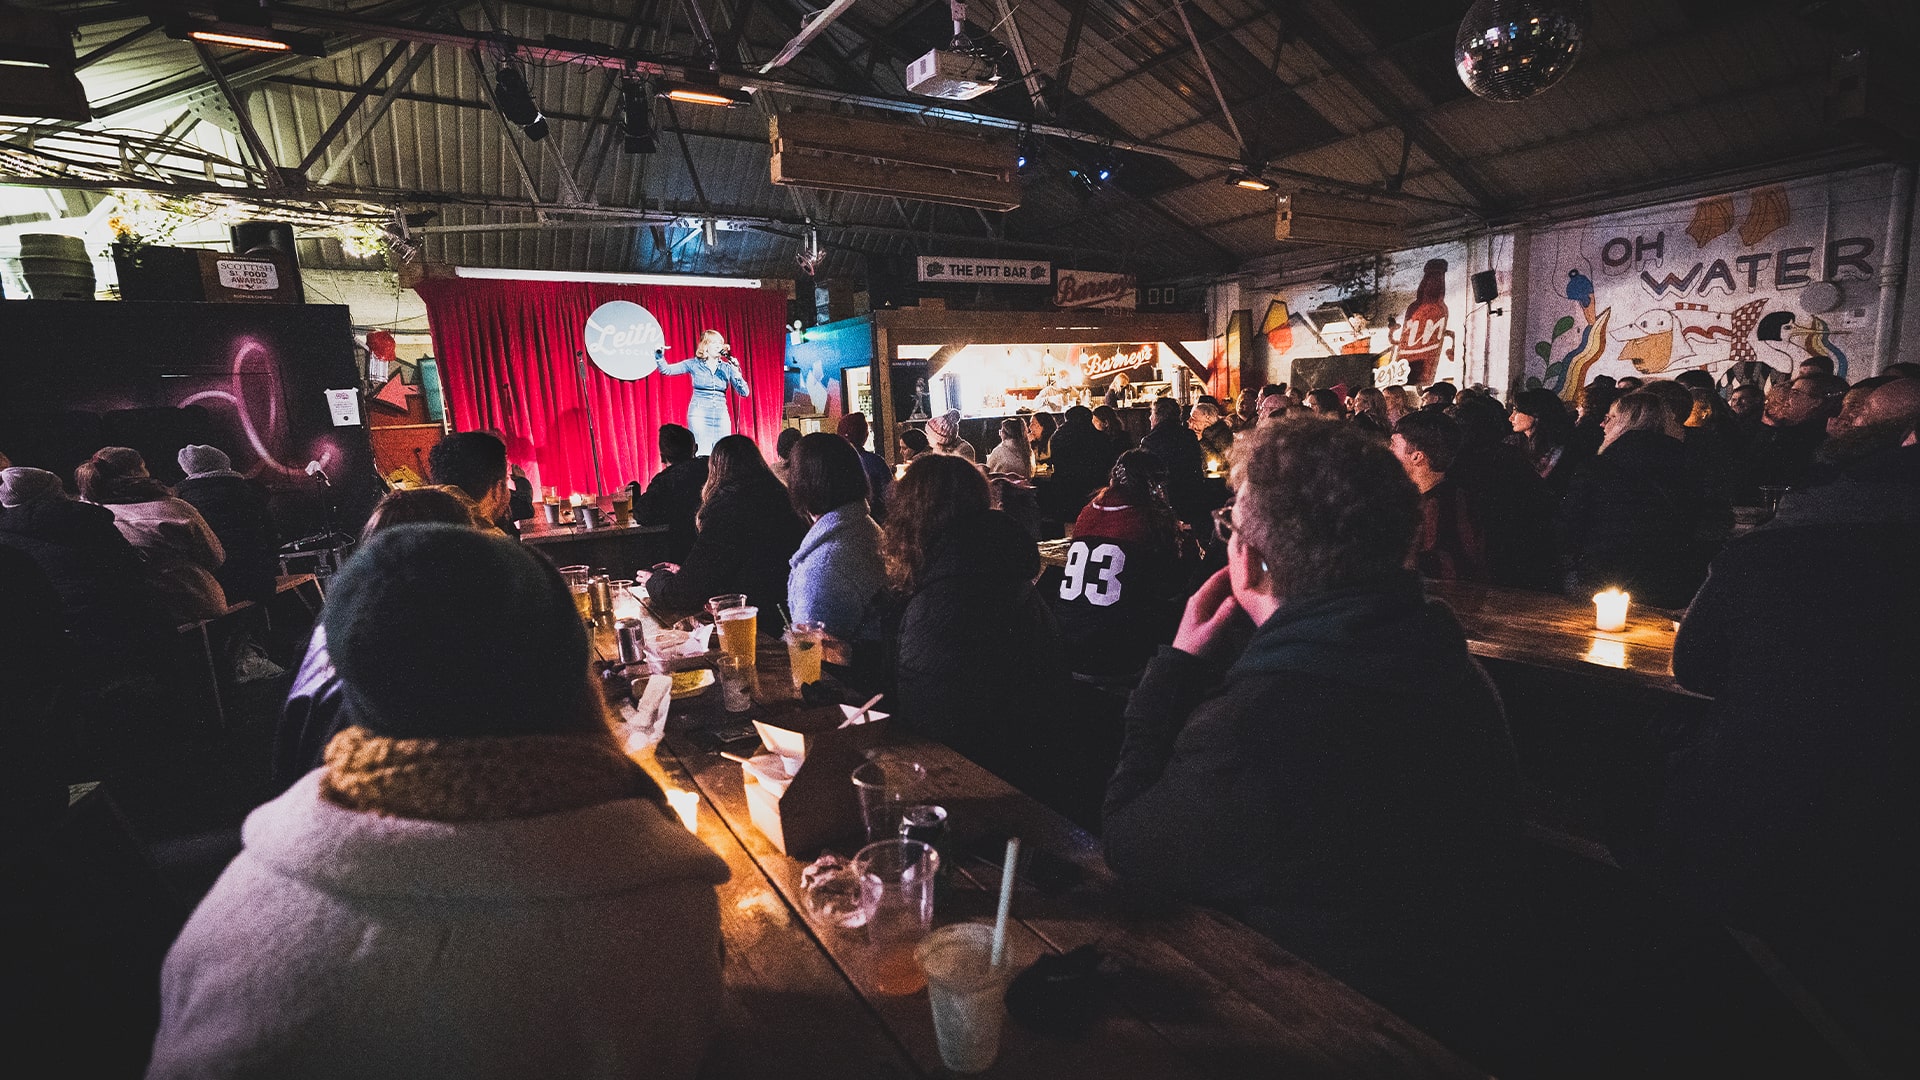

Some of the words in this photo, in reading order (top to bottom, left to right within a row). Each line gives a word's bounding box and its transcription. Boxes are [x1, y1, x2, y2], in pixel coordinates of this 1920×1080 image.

[220, 262, 273, 272] SCOTTISH
[1602, 231, 1664, 272] OH
[1641, 236, 1874, 300] WATER
[231, 276, 268, 285] AWARDS
[243, 270, 267, 278] FOOD
[949, 264, 973, 276] THE
[975, 265, 1001, 277] PITT
[1003, 266, 1027, 278] BAR
[589, 322, 661, 356] Leith
[1084, 345, 1153, 379] Barney's
[1060, 541, 1126, 606] 93
